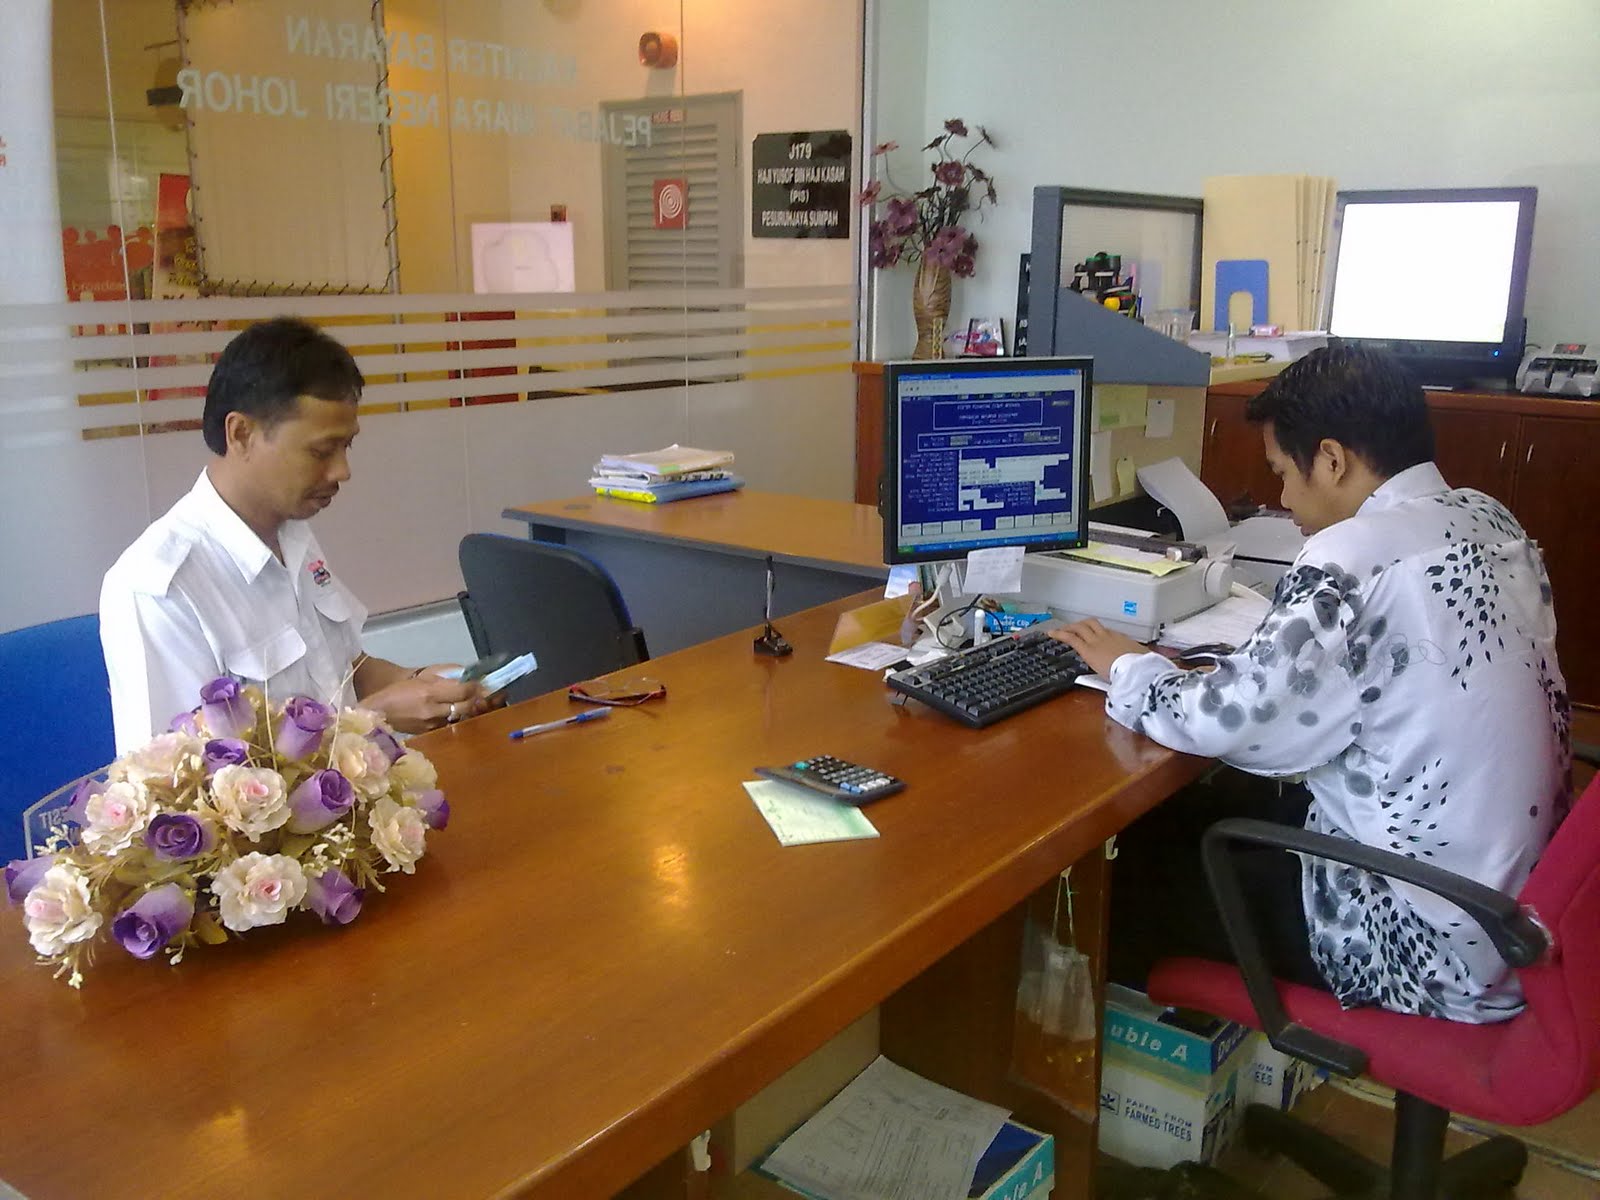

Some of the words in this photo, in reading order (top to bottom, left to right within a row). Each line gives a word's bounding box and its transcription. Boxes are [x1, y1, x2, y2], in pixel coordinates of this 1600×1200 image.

[789, 142, 812, 160] J179
[810, 210, 838, 226] SUMPAH
[1110, 1024, 1162, 1051] uble
[1171, 1044, 1187, 1062] A
[1125, 1106, 1160, 1130] FARMED
[1163, 1121, 1192, 1142] TREES
[1126, 1097, 1158, 1113] PAPER
[1164, 1112, 1192, 1128] FROM
